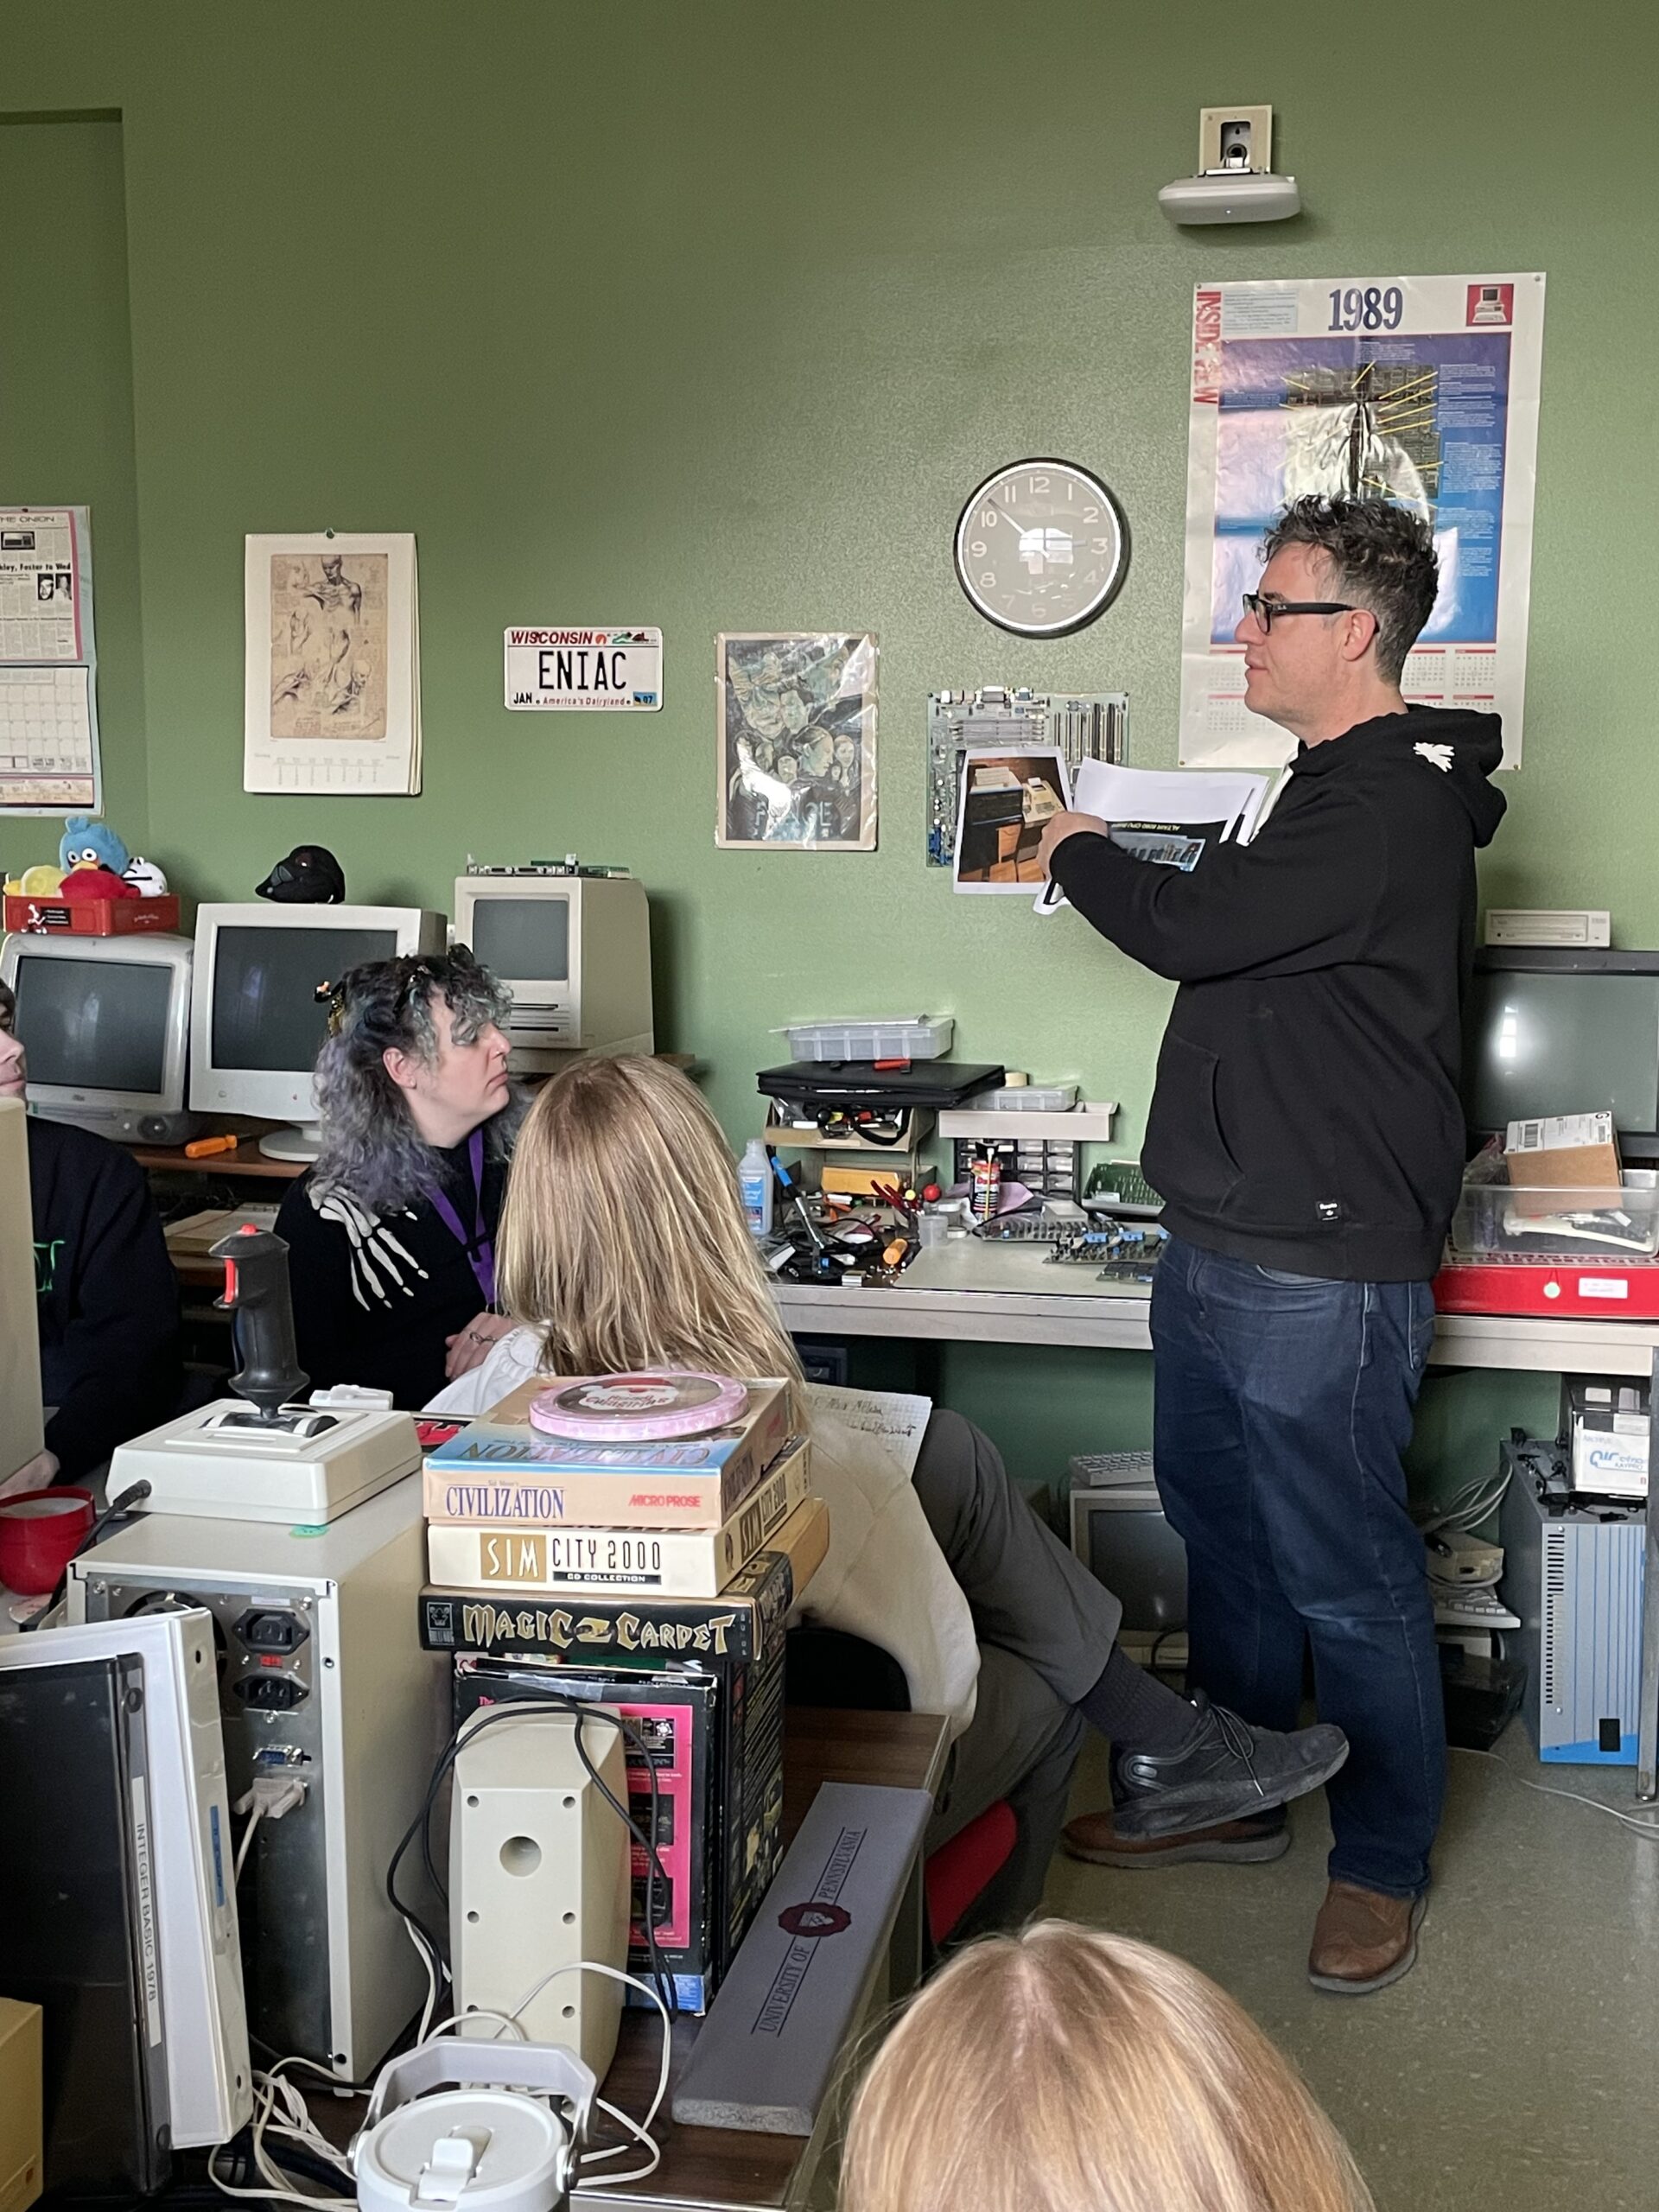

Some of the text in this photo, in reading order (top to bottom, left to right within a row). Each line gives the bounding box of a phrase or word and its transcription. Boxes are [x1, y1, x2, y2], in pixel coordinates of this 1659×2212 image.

[1328, 287, 1403, 331] 1989
[1030, 477, 1050, 493] 12
[1068, 483, 1072, 500] 1
[1005, 486, 1015, 503] 11
[982, 511, 997, 527] 10
[1084, 507, 1098, 524] 2
[971, 541, 987, 557] 9
[1090, 537, 1108, 555] 3
[980, 572, 996, 588] 8
[1084, 570, 1099, 586] 4
[1001, 594, 1015, 610] 7
[511, 631, 594, 645] WISCONSIN
[539, 651, 626, 690] ENIAC
[513, 692, 532, 704] JAN
[543, 696, 625, 708] America's Dairyland
[458, 1441, 710, 1466] CIVILIZATION
[446, 1486, 564, 1519] CIVILIZATION
[486, 1538, 661, 1579] SIM CITY 2000
[567, 1573, 646, 1583] CD COLLECTION
[462, 1604, 574, 1649] MAGIC
[615, 1611, 738, 1655] CARPET
[136, 1823, 157, 2001] INTEGER BASIC 1978
[759, 1830, 861, 2032] UNIVERSITY OF PENNSYLVANIA
